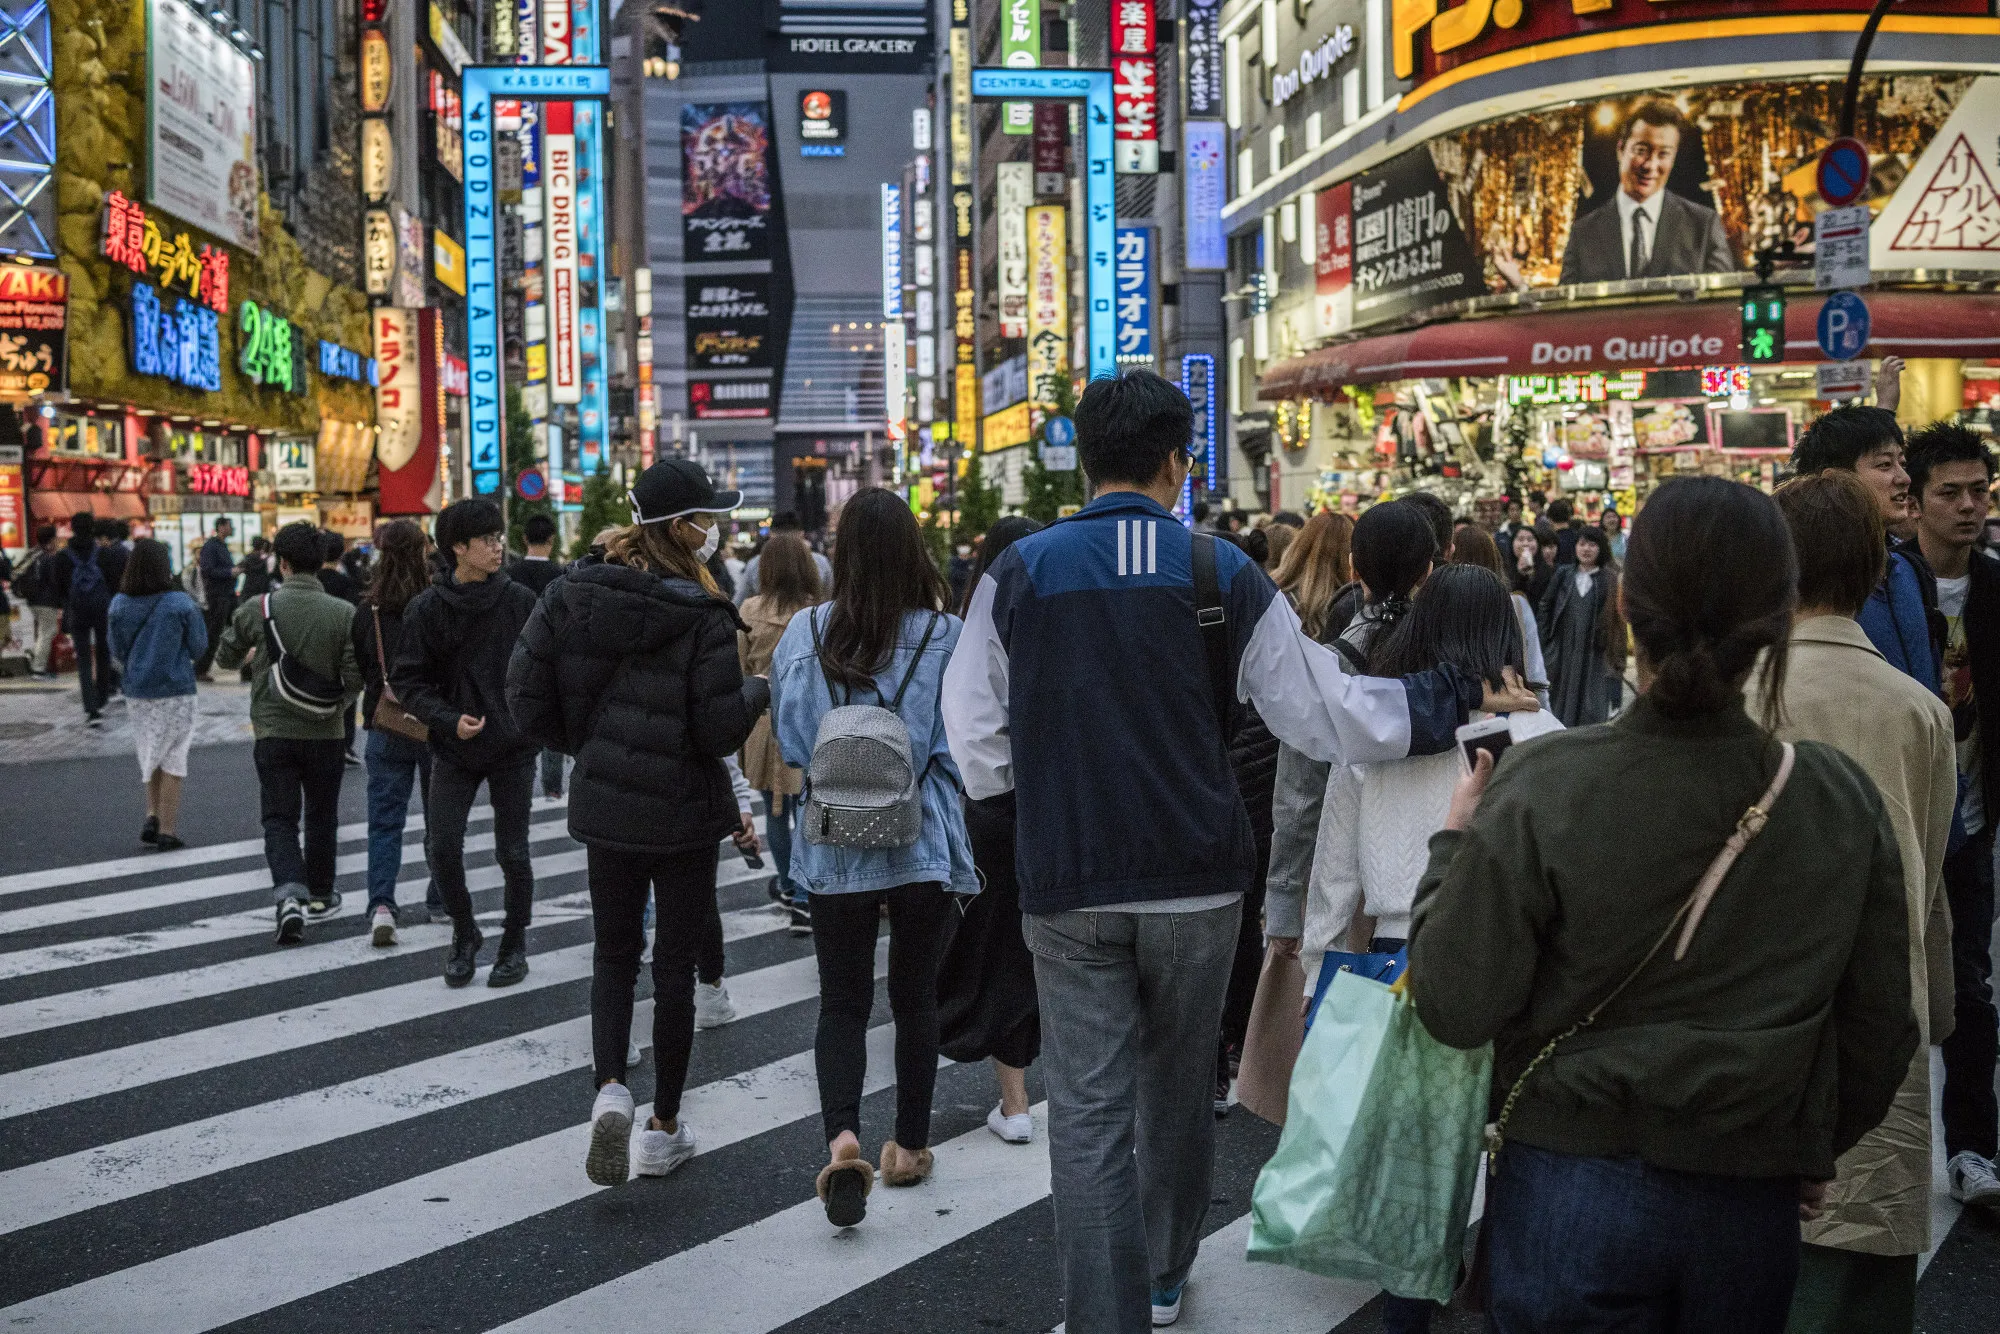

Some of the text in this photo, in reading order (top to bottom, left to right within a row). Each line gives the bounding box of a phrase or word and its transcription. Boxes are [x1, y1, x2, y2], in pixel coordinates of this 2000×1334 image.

[790, 38, 917, 53] HOTEL GRACERY
[979, 77, 1091, 89] CENTRAL ROAD
[1272, 69, 1299, 107] Don
[1300, 24, 1352, 84] Quijote
[552, 150, 571, 259] BIC DRUG
[470, 130, 494, 434] GODZILLA ROAD
[1117, 232, 1148, 353] カラオケ
[380, 317, 402, 409] トラノコ
[1531, 334, 1724, 365] Don Quijote
[1827, 308, 1850, 352] P
